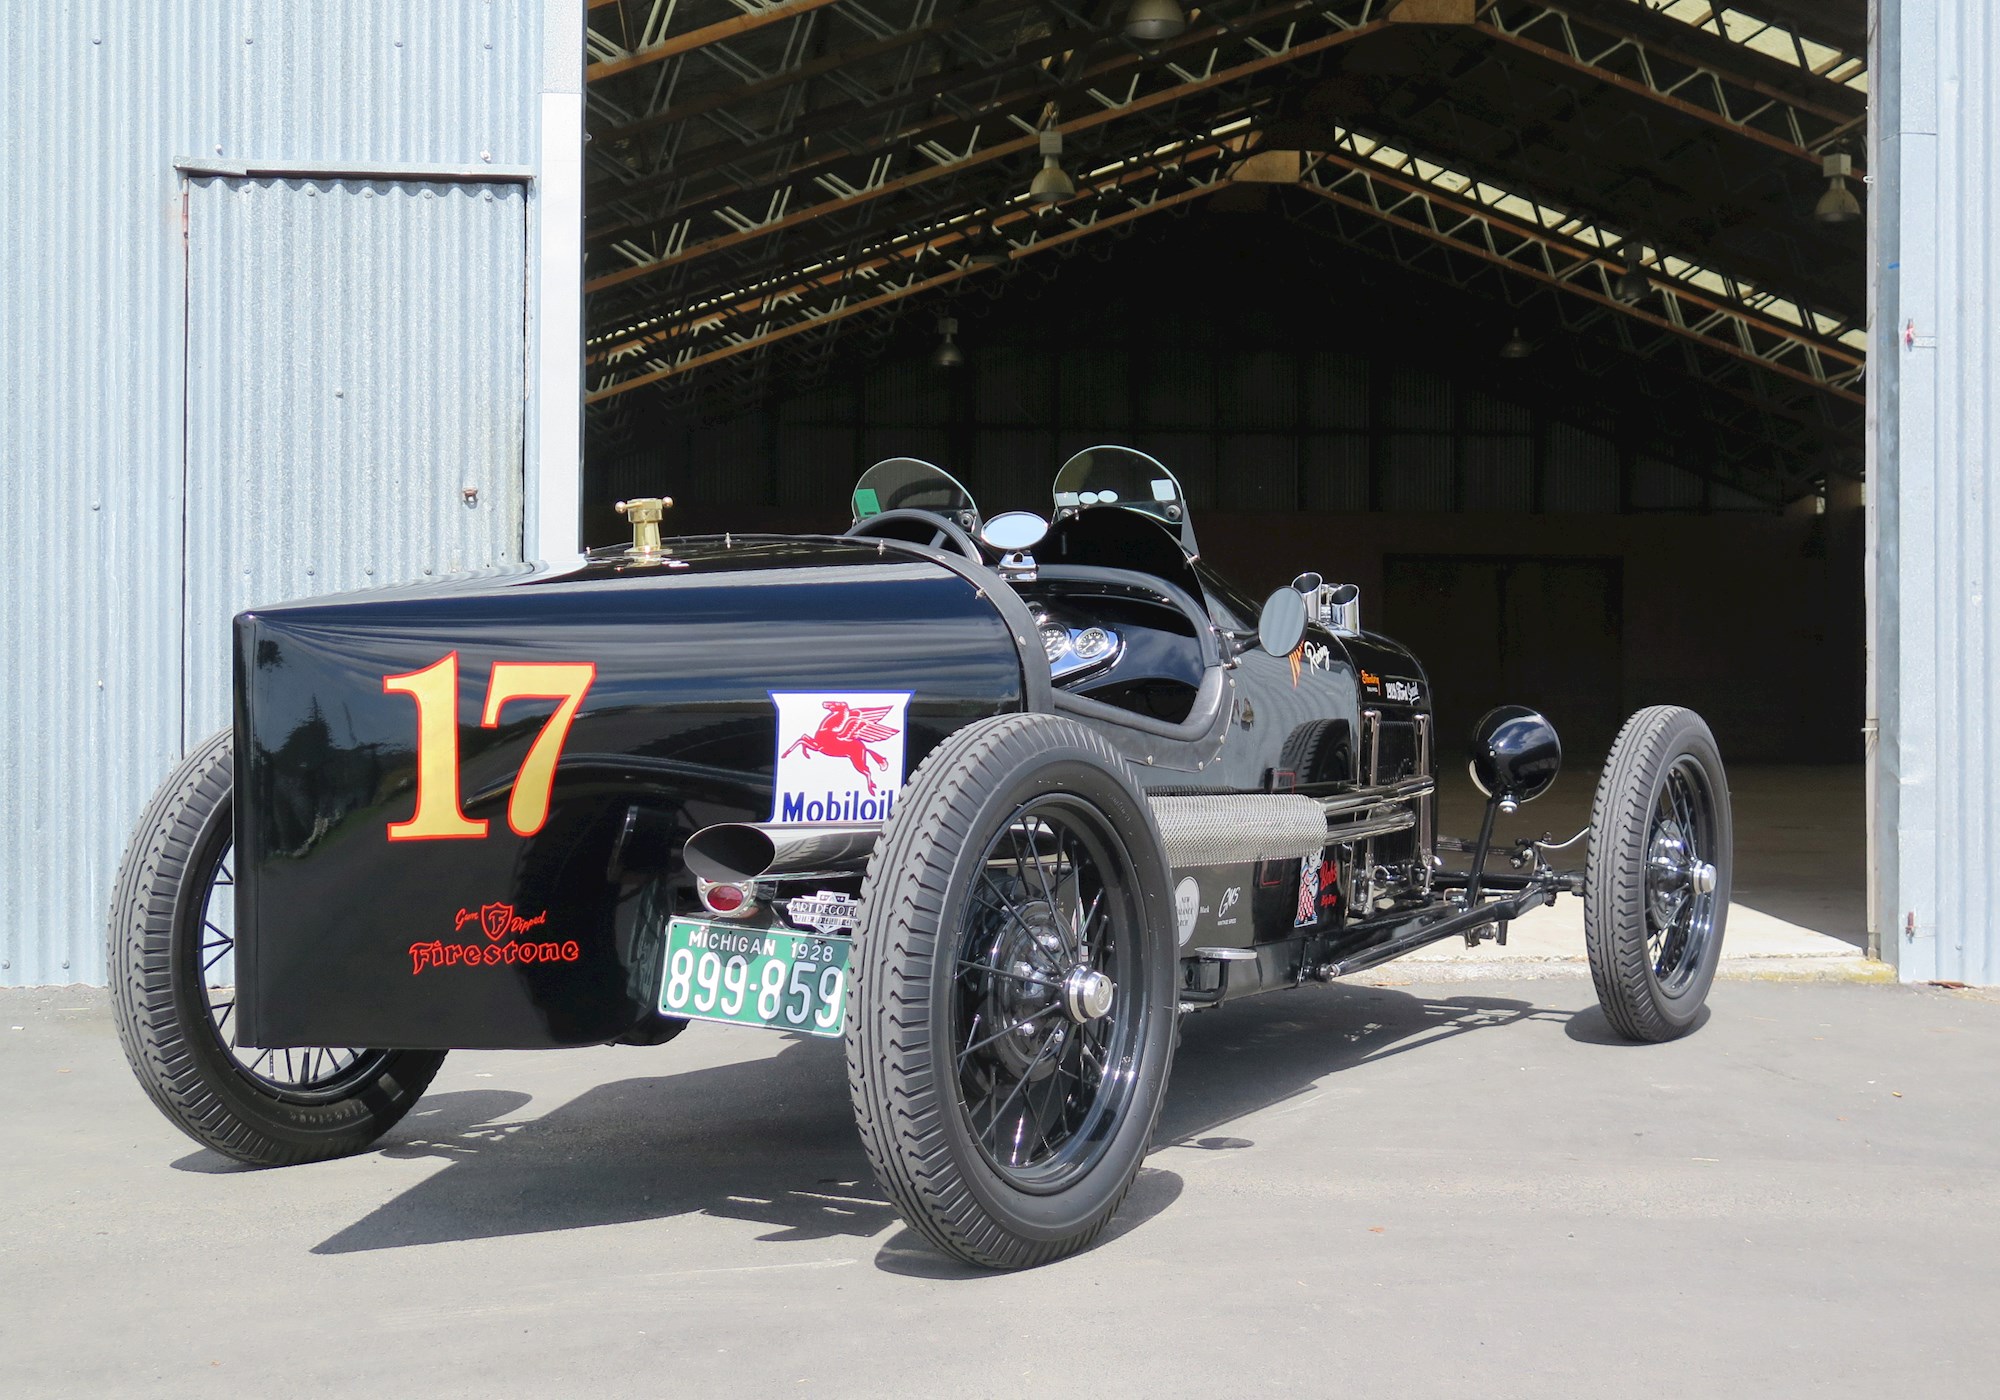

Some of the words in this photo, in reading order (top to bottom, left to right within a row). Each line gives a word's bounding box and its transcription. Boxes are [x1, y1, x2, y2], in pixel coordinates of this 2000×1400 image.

[382, 650, 596, 842] 17
[781, 789, 894, 822] Mobiloil
[455, 908, 479, 931] Gum
[511, 910, 547, 934] Dipped
[793, 902, 814, 913] ART
[815, 903, 846, 916] DECO
[409, 940, 579, 975] Firestone
[688, 929, 776, 956] MICHIGAN
[791, 941, 834, 962] 1928
[666, 948, 844, 1029] 899-859
